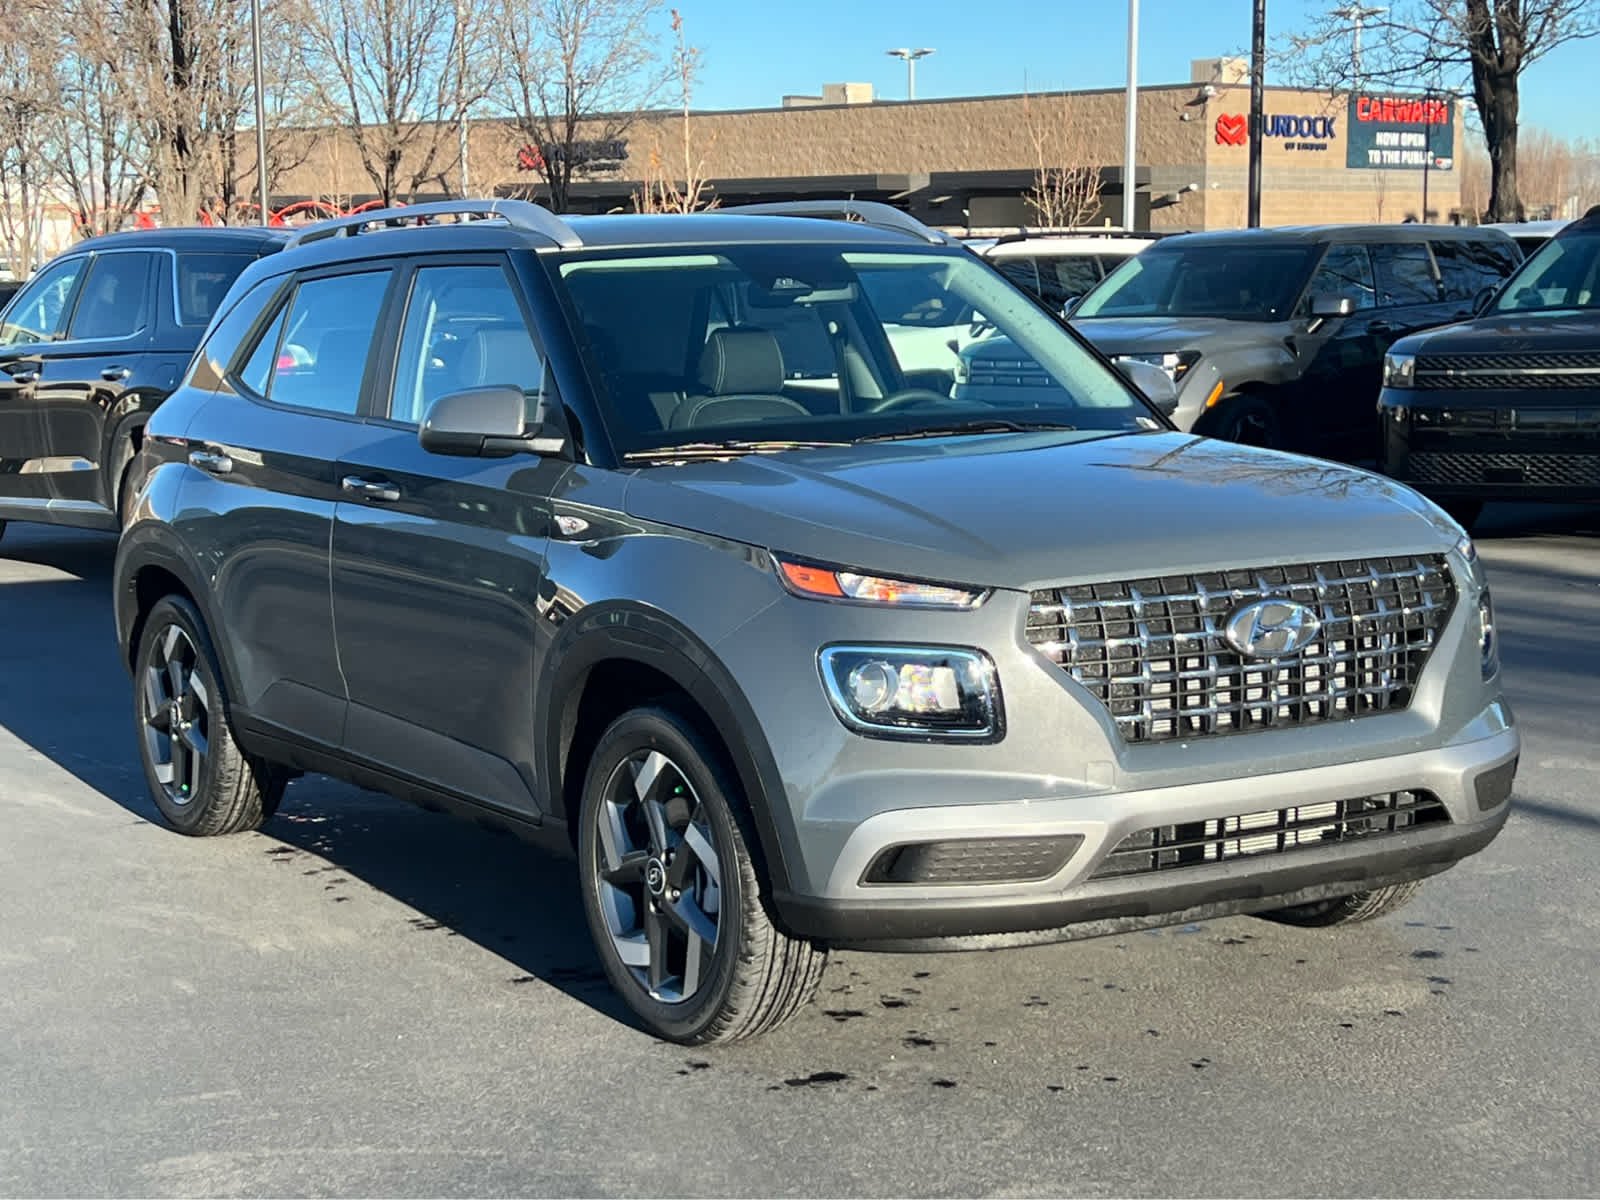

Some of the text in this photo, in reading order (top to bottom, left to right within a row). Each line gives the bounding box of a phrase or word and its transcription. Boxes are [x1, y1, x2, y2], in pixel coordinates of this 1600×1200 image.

[1357, 97, 1449, 125] CARWASH
[1248, 114, 1336, 139] URDOCK
[1375, 131, 1426, 147] NOW OPEN
[1368, 149, 1381, 164] TO
[1382, 149, 1401, 164] THE
